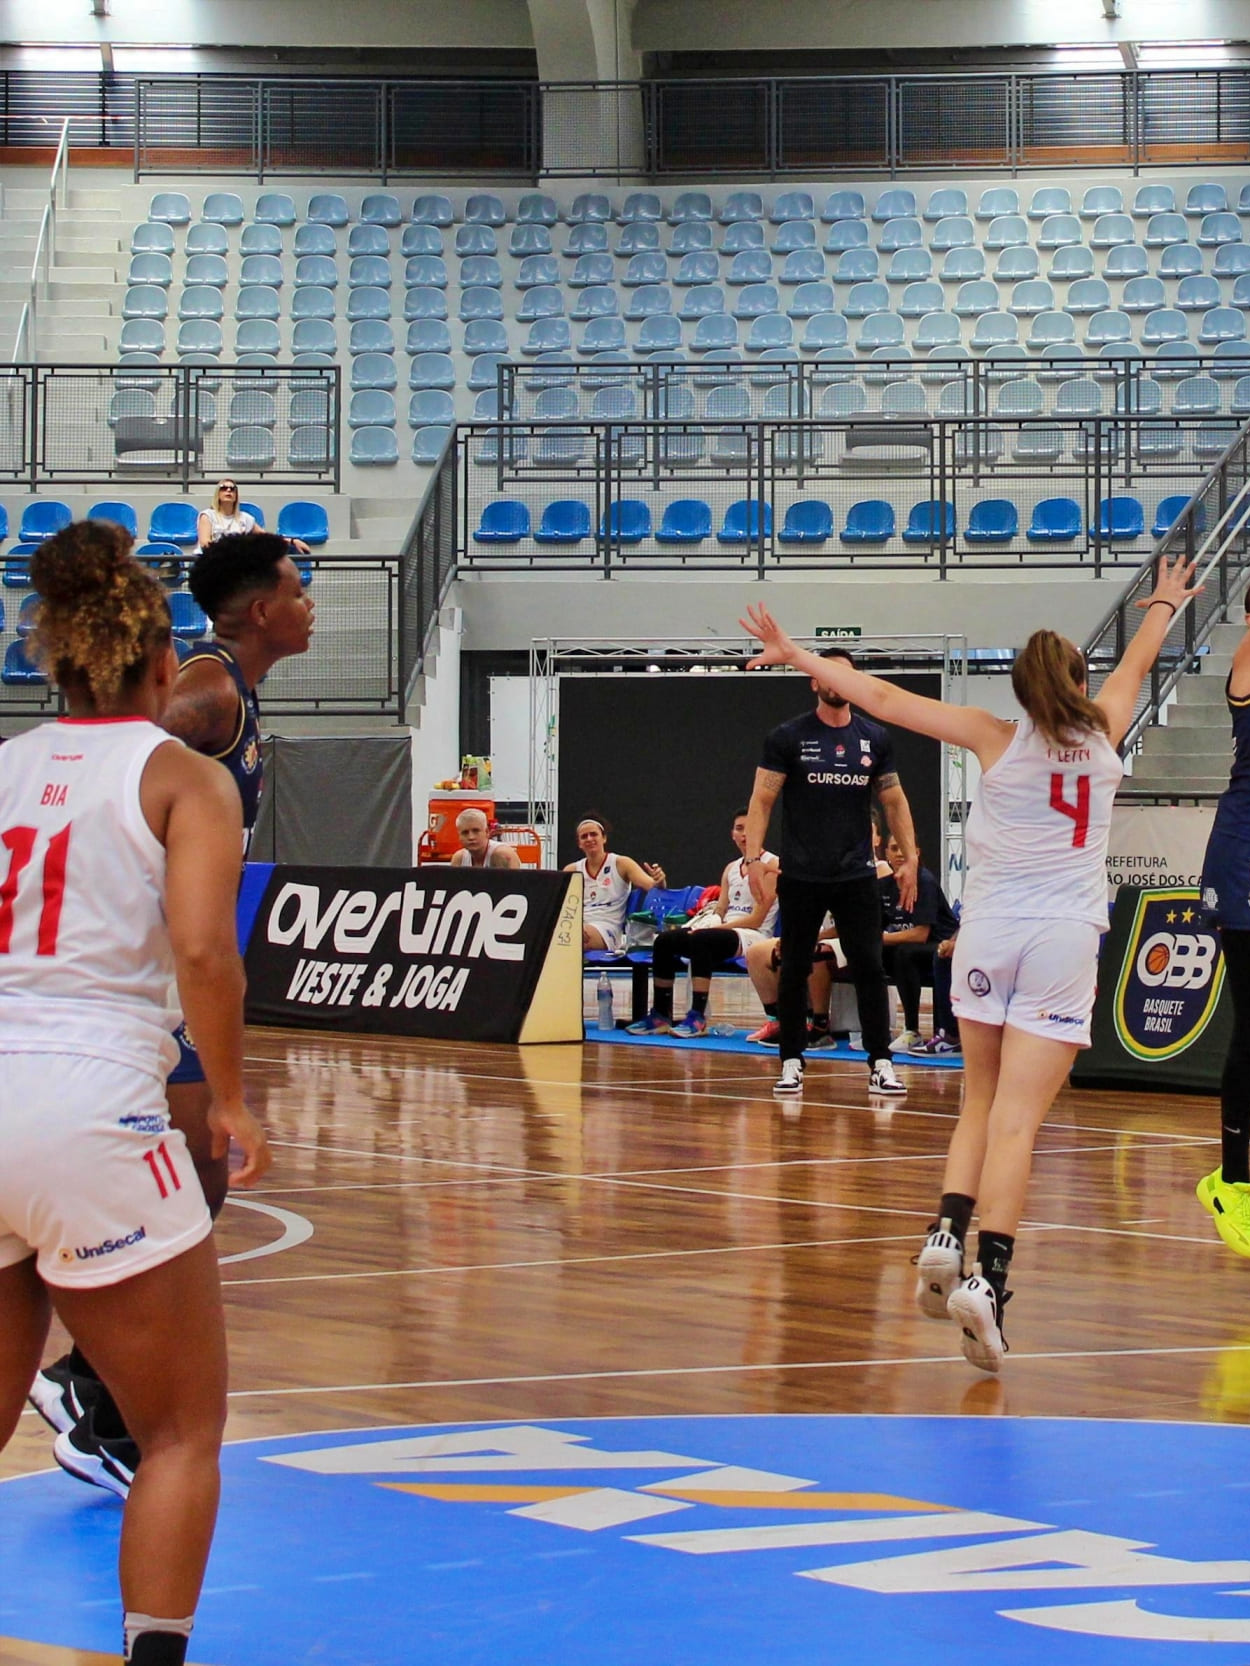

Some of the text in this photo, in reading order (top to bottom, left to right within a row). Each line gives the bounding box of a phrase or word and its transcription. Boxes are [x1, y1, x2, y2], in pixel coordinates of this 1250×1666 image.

[1057, 749, 1090, 763] LETTY
[41, 784, 68, 806] BIA
[1050, 773, 1091, 848] 4
[1105, 856, 1168, 868] REFEITURA
[0, 820, 72, 956] 11
[1107, 872, 1123, 885] ÃO
[1159, 874, 1185, 886] DOS
[286, 959, 470, 1012] VESTE & JOGA
[1143, 998, 1185, 1016] BASQUETE
[1144, 1016, 1172, 1032] BRASIL
[142, 1141, 181, 1200] 11
[76, 1226, 146, 1260] UniSecal
